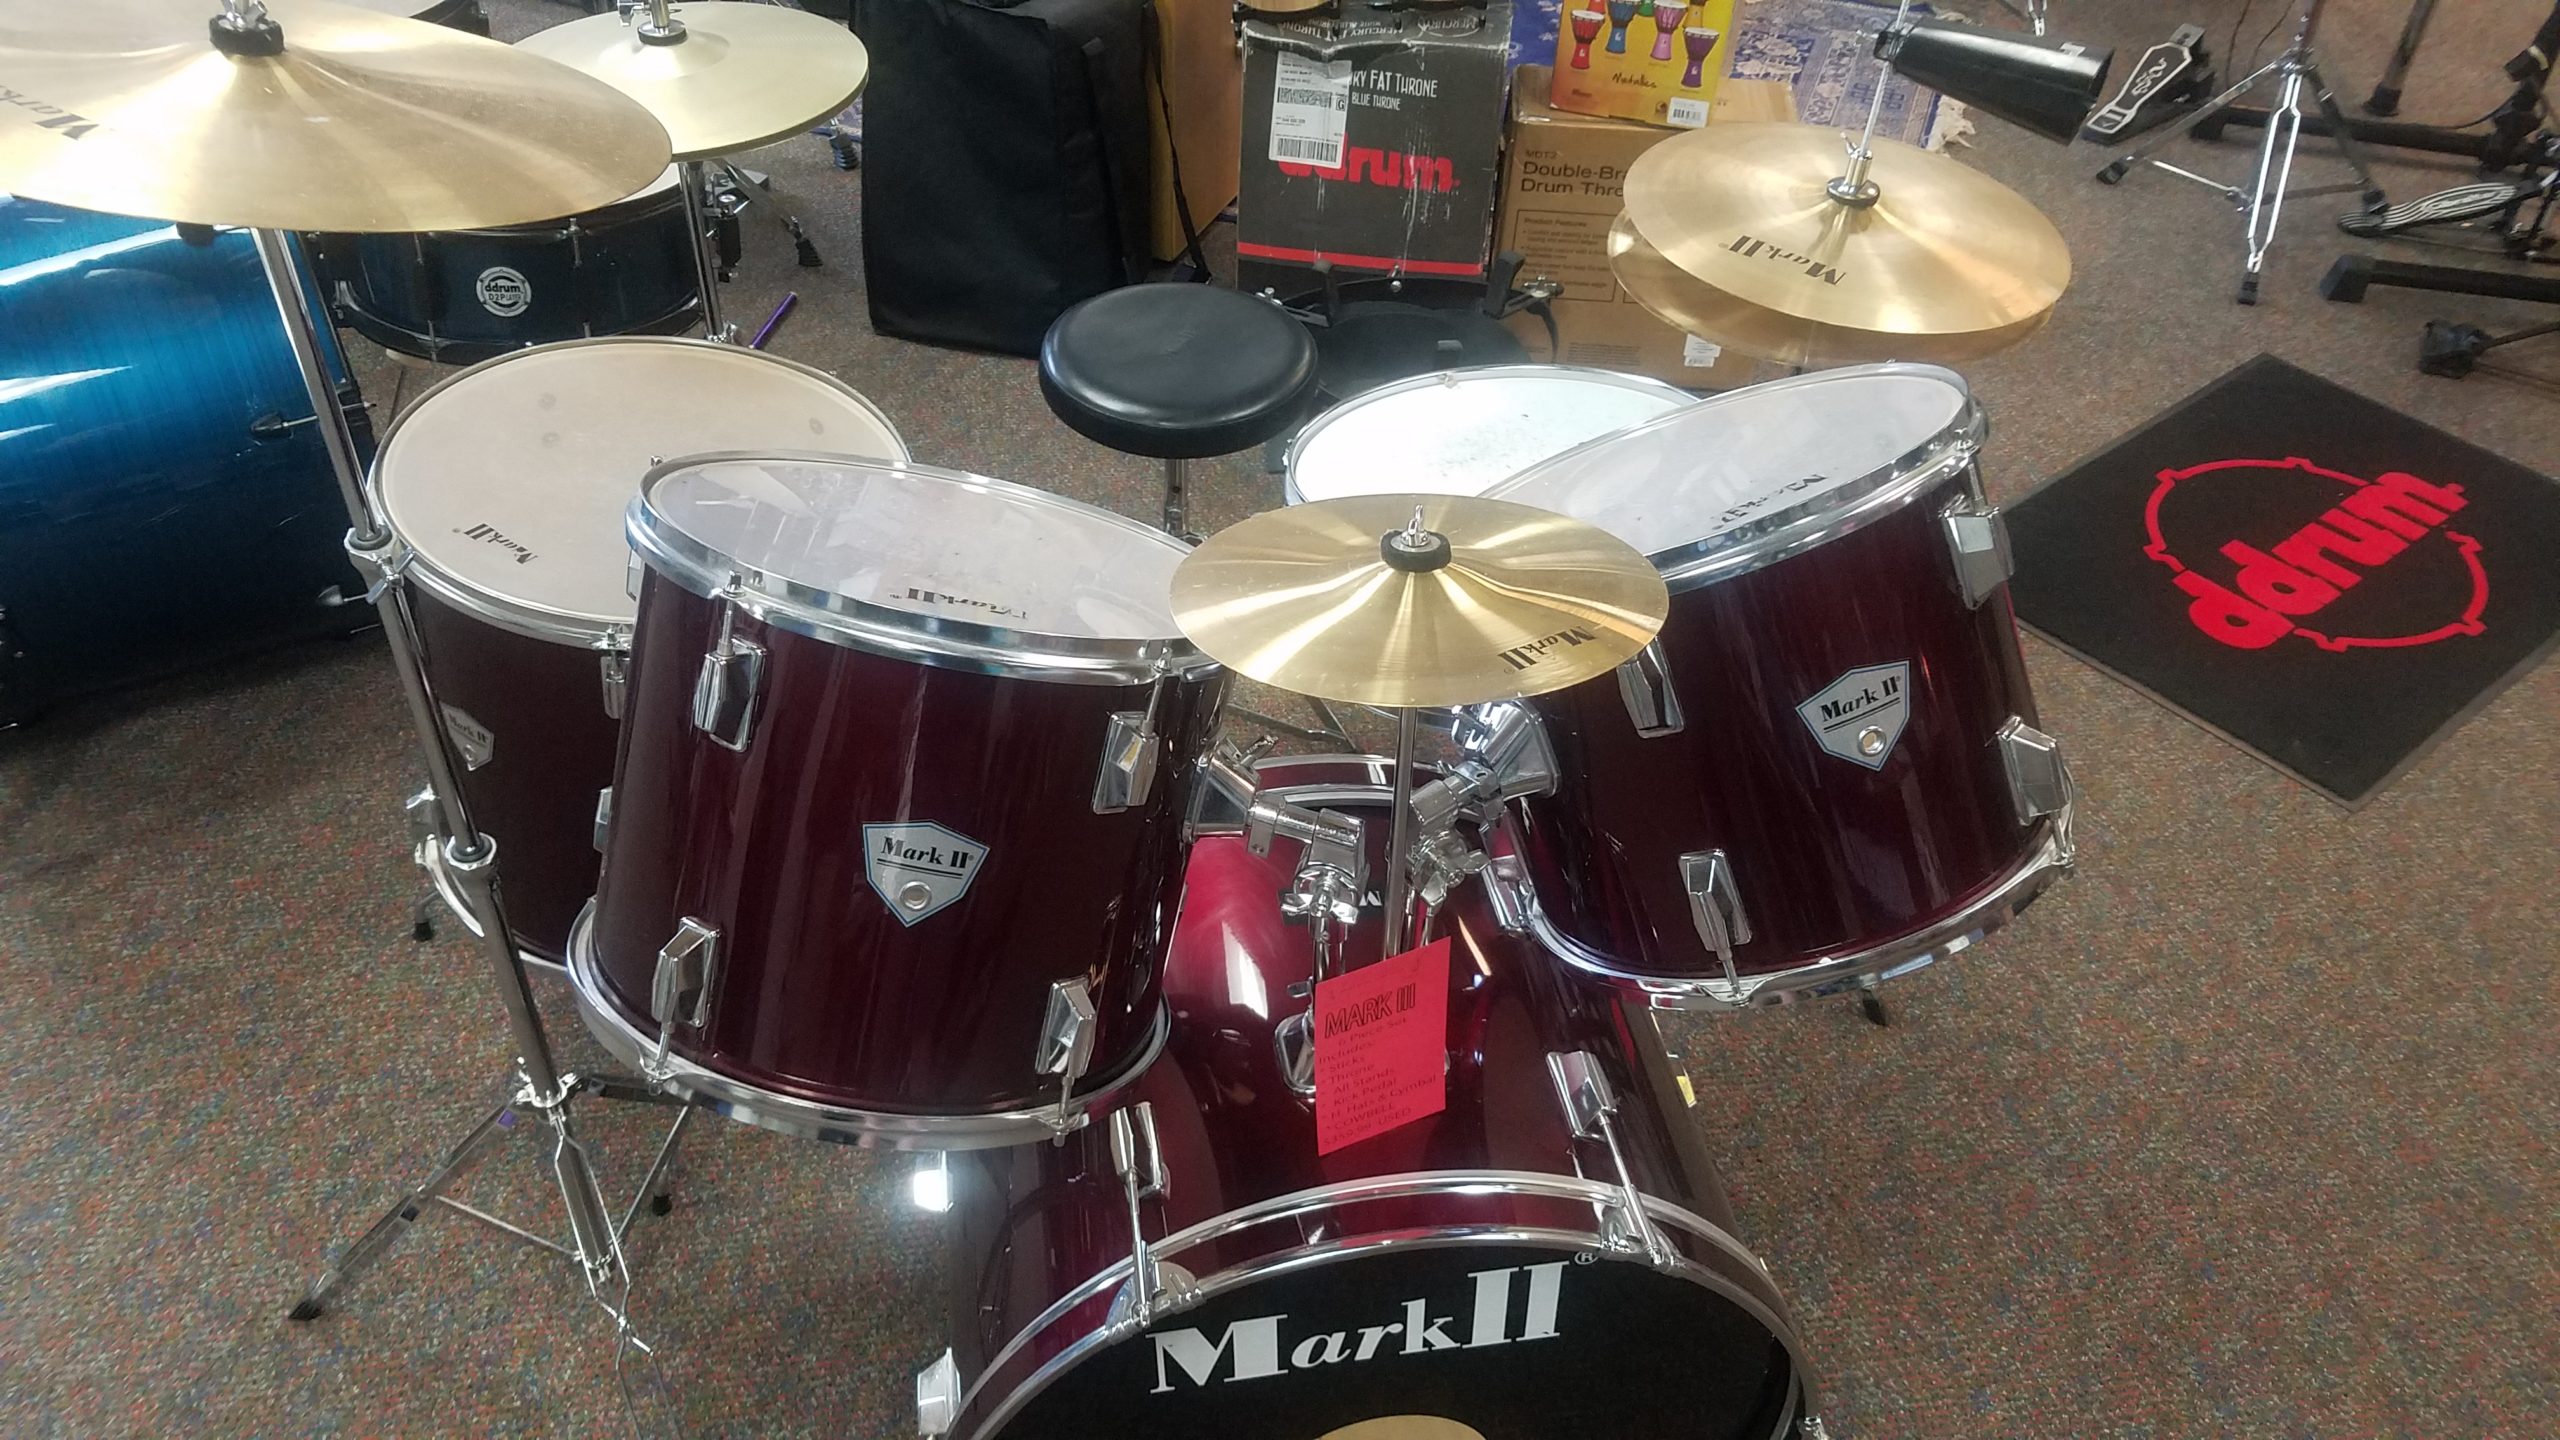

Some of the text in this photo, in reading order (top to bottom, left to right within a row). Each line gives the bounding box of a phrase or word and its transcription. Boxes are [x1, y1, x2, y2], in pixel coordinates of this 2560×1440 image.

[1370, 70, 1393, 92] FAT
[1395, 74, 1438, 98] THRONE
[1352, 92, 1401, 111] BLUE THRONE
[1521, 178, 1573, 194] Drum
[485, 281, 521, 294] ddrum
[2172, 472, 2470, 649] ddrum
[1820, 675, 1899, 722] Mark II
[880, 836, 970, 869] Mark II
[1325, 982, 1416, 1038] MARK III
[1349, 1023, 1383, 1043] Piece
